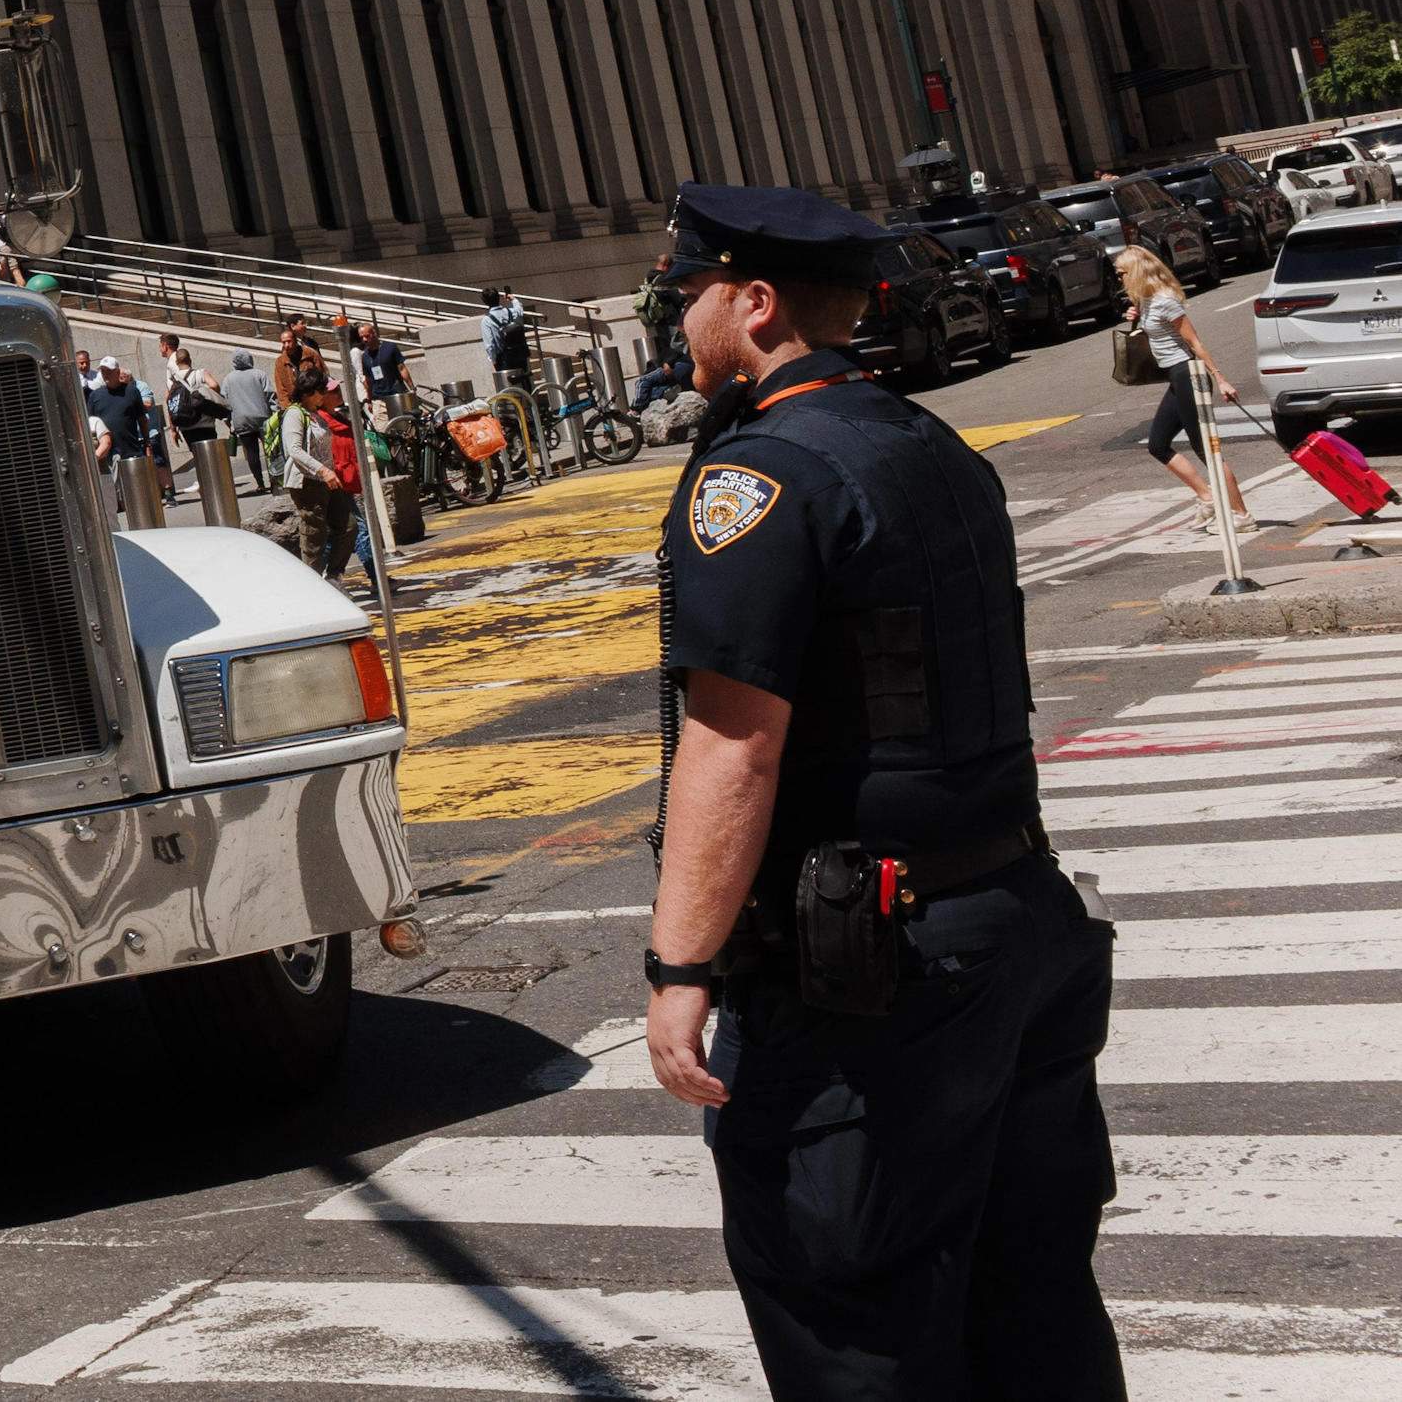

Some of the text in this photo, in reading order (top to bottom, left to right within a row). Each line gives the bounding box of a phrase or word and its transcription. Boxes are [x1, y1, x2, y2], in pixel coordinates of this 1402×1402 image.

[702, 478, 768, 504] DEPARTMENT
[720, 470, 759, 489] POLICE
[694, 498, 706, 536] CITY OF
[715, 506, 764, 544] NEW YORK
